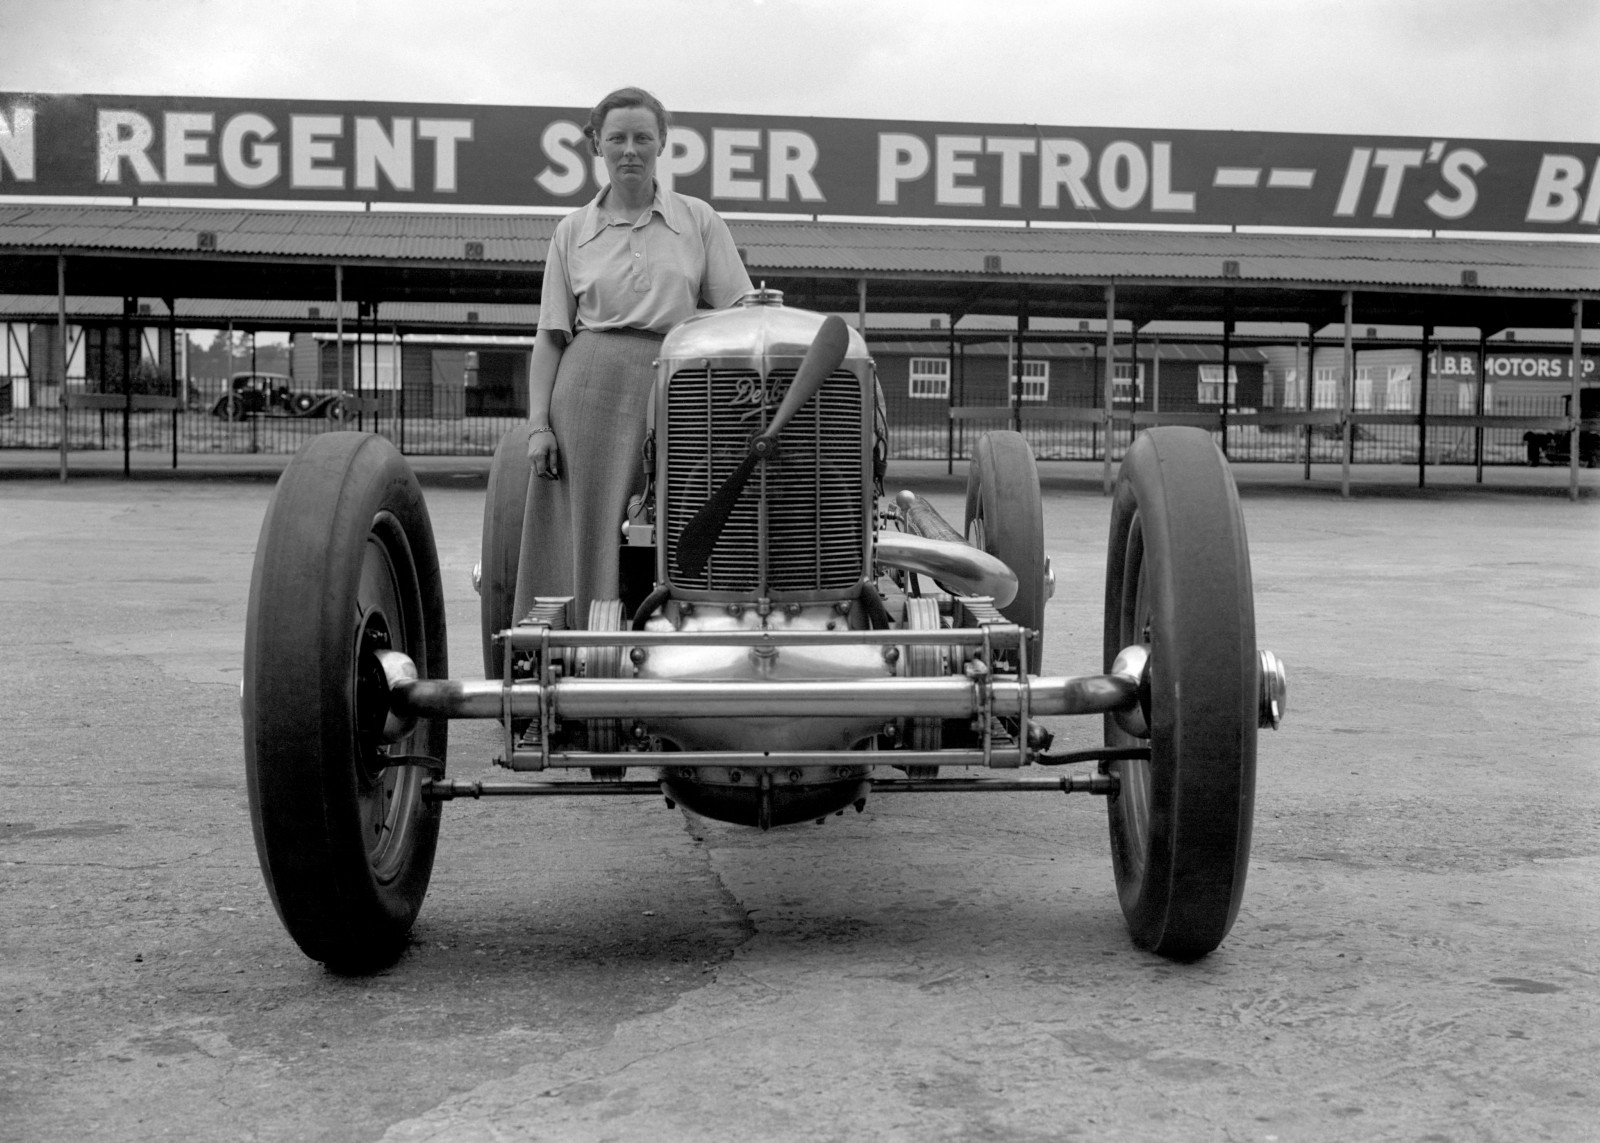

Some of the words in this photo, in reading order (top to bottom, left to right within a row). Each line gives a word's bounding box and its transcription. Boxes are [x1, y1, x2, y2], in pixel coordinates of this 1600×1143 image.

[97, 108, 475, 193] REGENT
[534, 119, 827, 202] SPER
[877, 132, 1196, 212] PETROL
[1333, 140, 1488, 220] IT'S
[200, 233, 214, 247] 21
[466, 243, 484, 256] 20
[986, 256, 1000, 269] 18
[1225, 261, 1238, 275] 17
